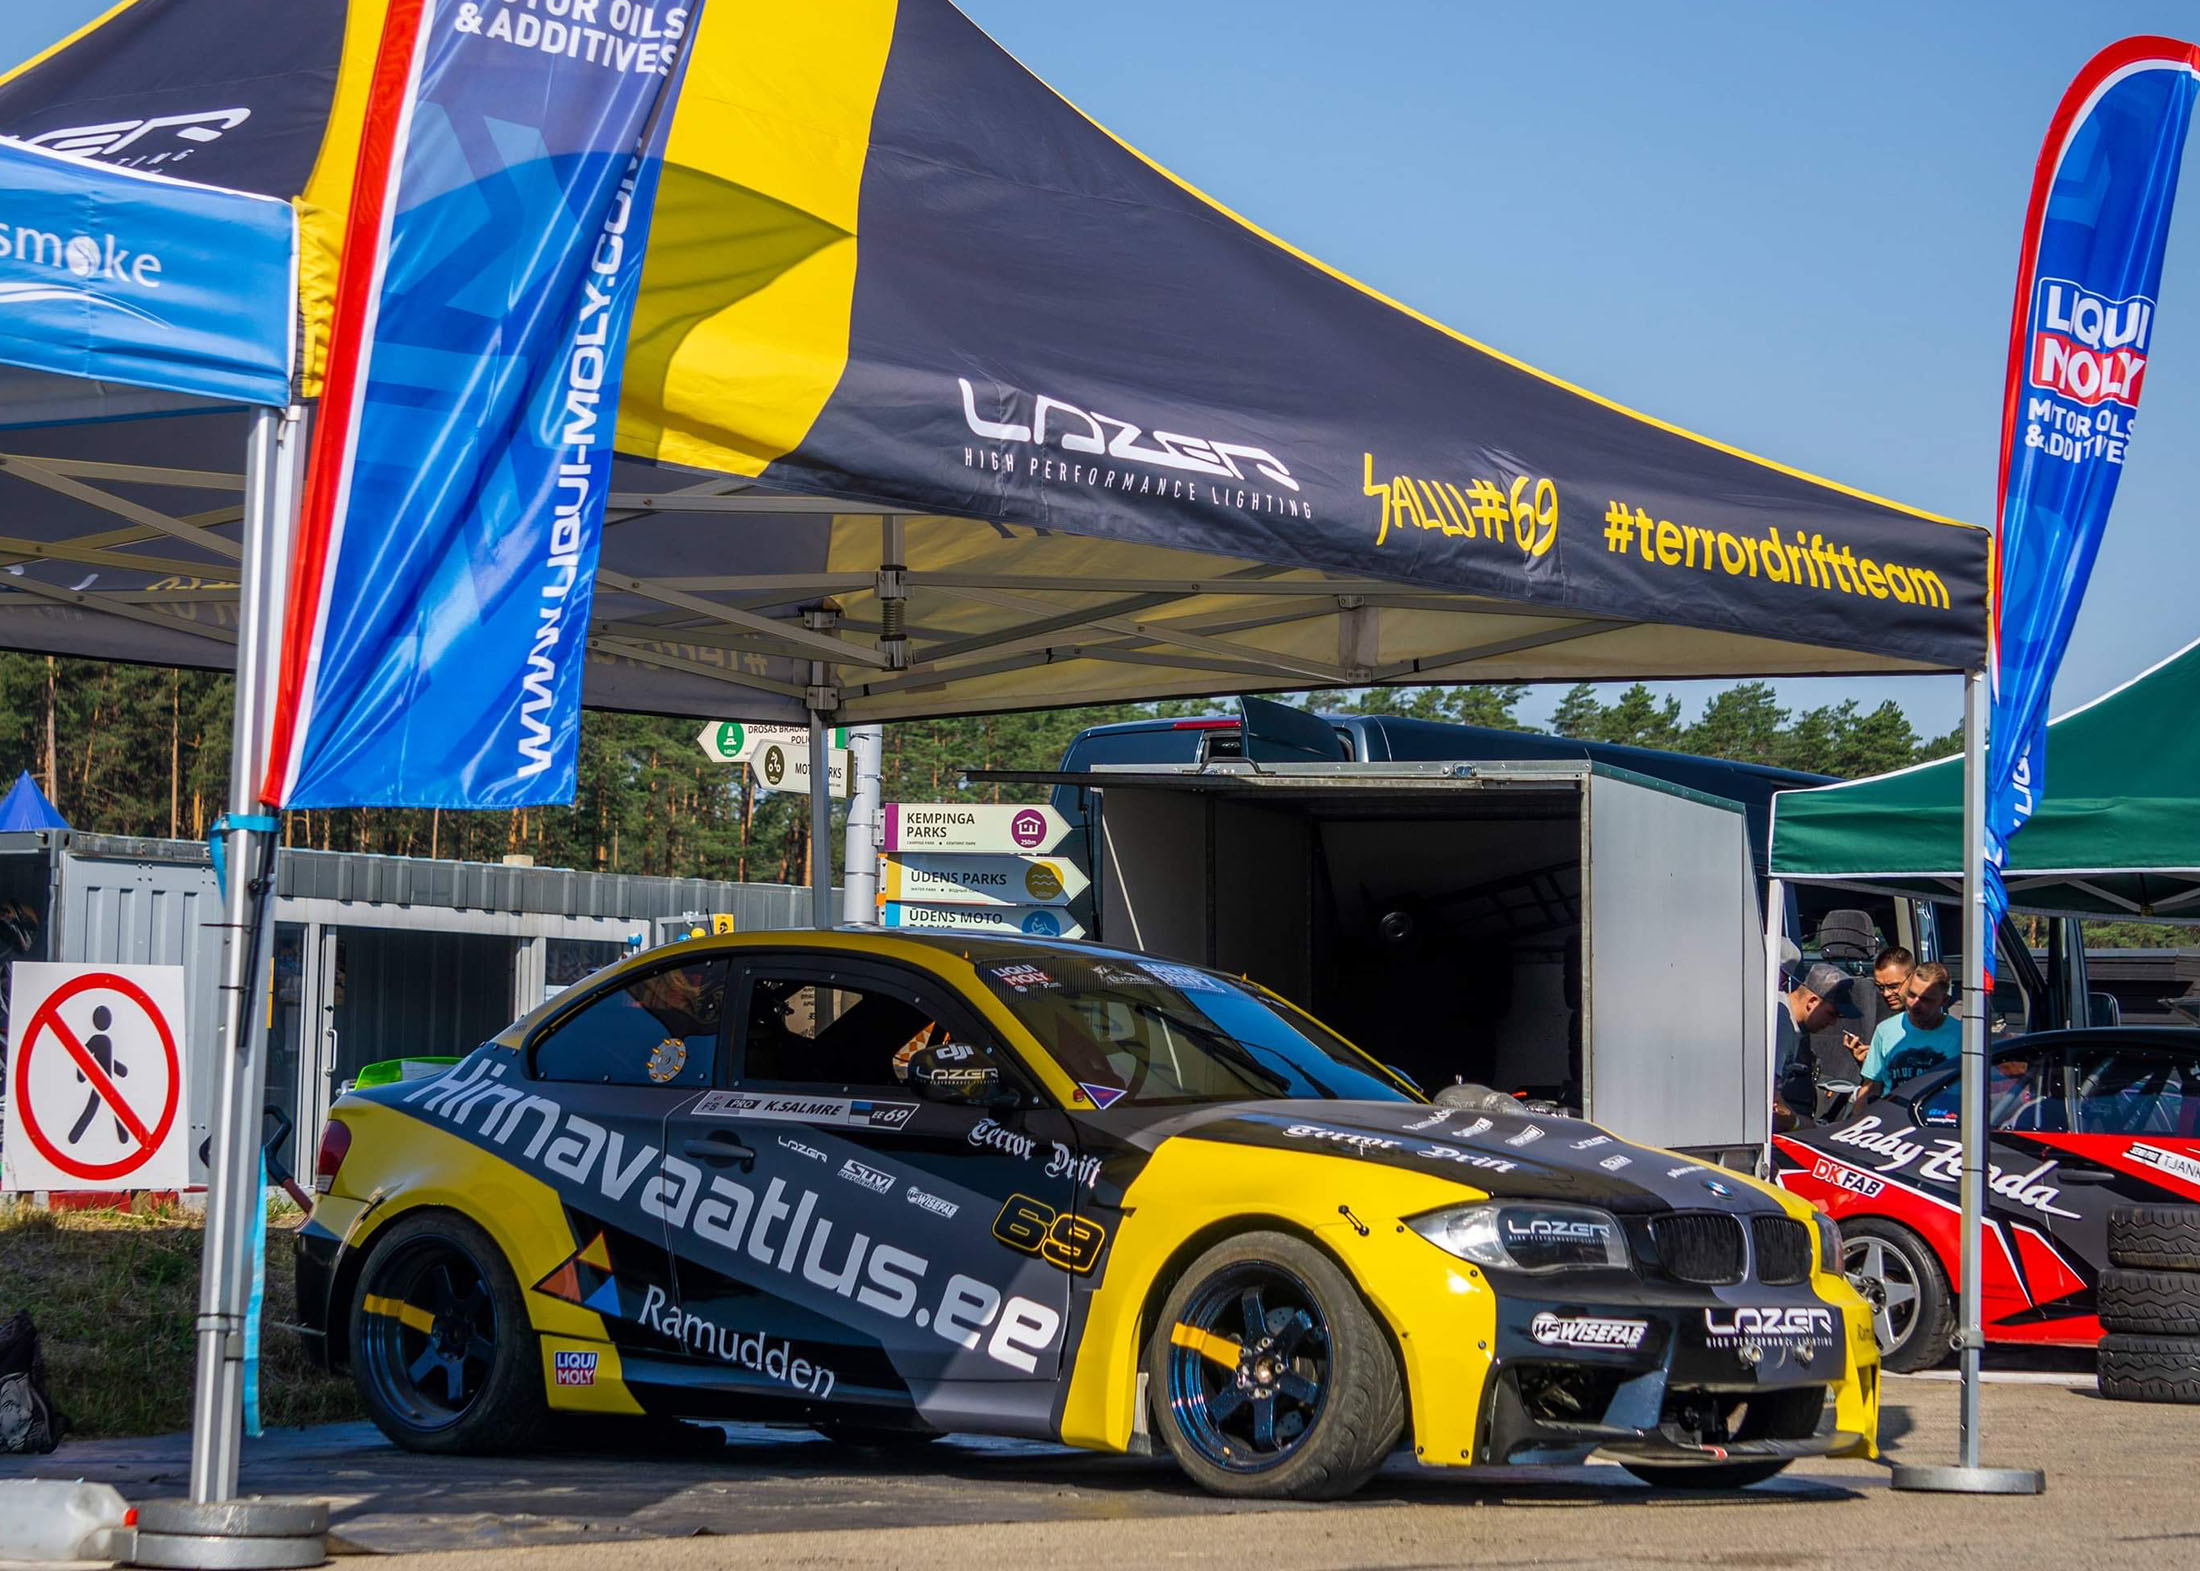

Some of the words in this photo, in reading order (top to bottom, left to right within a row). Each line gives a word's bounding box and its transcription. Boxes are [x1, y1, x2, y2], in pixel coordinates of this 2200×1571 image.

[609, 0, 689, 40] OILS
[2046, 285, 2151, 350] LIQUI
[2028, 398, 2091, 437] MTOR
[2095, 410, 2135, 441] OLS
[958, 378, 1300, 491] LAZER
[964, 447, 1015, 473] HIGH
[1030, 461, 1195, 501] PERFORMANCE
[1211, 487, 1312, 520] LIGHTING
[1604, 500, 1951, 610] #terrordriftteam
[791, 736, 810, 744] POLI
[907, 813, 975, 824] KEMPINGA
[907, 827, 947, 838] PARKS
[911, 870, 958, 884] ŪDENS
[962, 872, 1007, 886] PARKS
[909, 908, 956, 922] ŪDENS
[960, 912, 1003, 924] MOTO
[991, 964, 1038, 978] LIQUI
[1003, 972, 1049, 985] MOLY
[916, 1066, 999, 1081] LAZER
[730, 1099, 753, 1109] PRO
[764, 1100, 843, 1116] K.SALMRE
[884, 1109, 909, 1122] 69
[968, 1118, 1038, 1160] Terror
[1045, 1140, 1103, 1189] Drift
[1830, 1115, 1924, 1171] Baby
[405, 1056, 1059, 1374] Hinnavaatlus.ee
[992, 1193, 1105, 1272] 69
[1508, 1219, 1610, 1238] LAZER
[1560, 1321, 1645, 1343] WISEFAB
[1705, 1307, 1832, 1334] LAZER
[637, 1284, 836, 1399] Ramudden
[557, 1353, 596, 1368] LIQUI
[557, 1369, 594, 1384] MOLY
